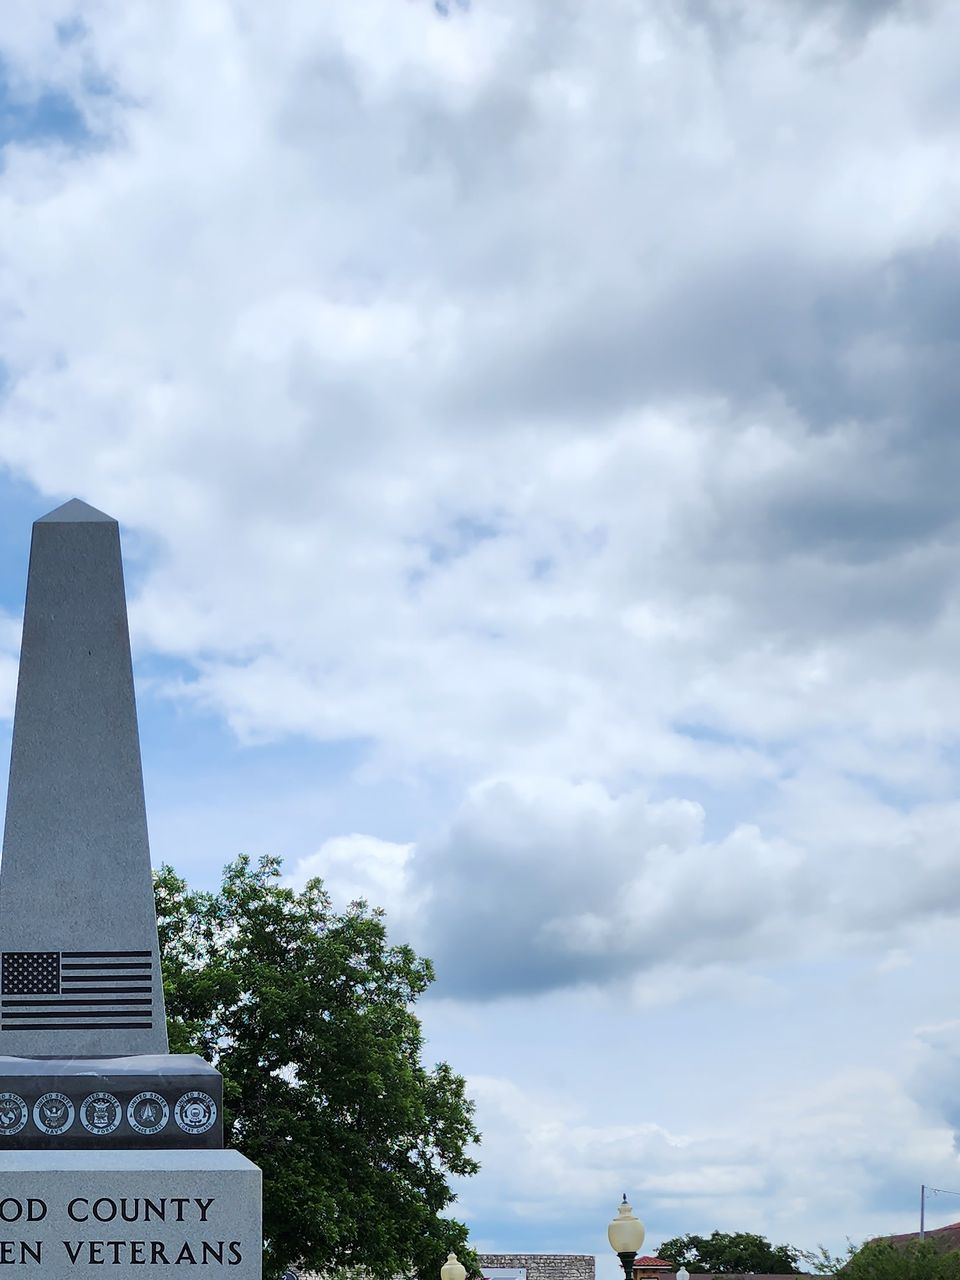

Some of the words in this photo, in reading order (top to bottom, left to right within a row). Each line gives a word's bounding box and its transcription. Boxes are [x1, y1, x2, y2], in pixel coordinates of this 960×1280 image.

[8, 1093, 26, 1109] STATES
[35, 1093, 53, 1109] UNITED
[55, 1093, 73, 1109] STATES
[81, 1093, 100, 1109] UNITED
[102, 1093, 120, 1109] STATES
[129, 1093, 147, 1109] UNITED
[150, 1093, 168, 1109] STATES
[176, 1092, 195, 1108] UNITED
[197, 1092, 215, 1108] STATES
[8, 1121, 24, 1134] CORPS
[85, 1123, 95, 1132] AIR
[96, 1124, 116, 1133] FORCE
[133, 1123, 147, 1133] SPACE
[148, 1124, 164, 1133] FORCE
[67, 1197, 216, 1223] COUNTY
[62, 1240, 242, 1266] VETERANS
